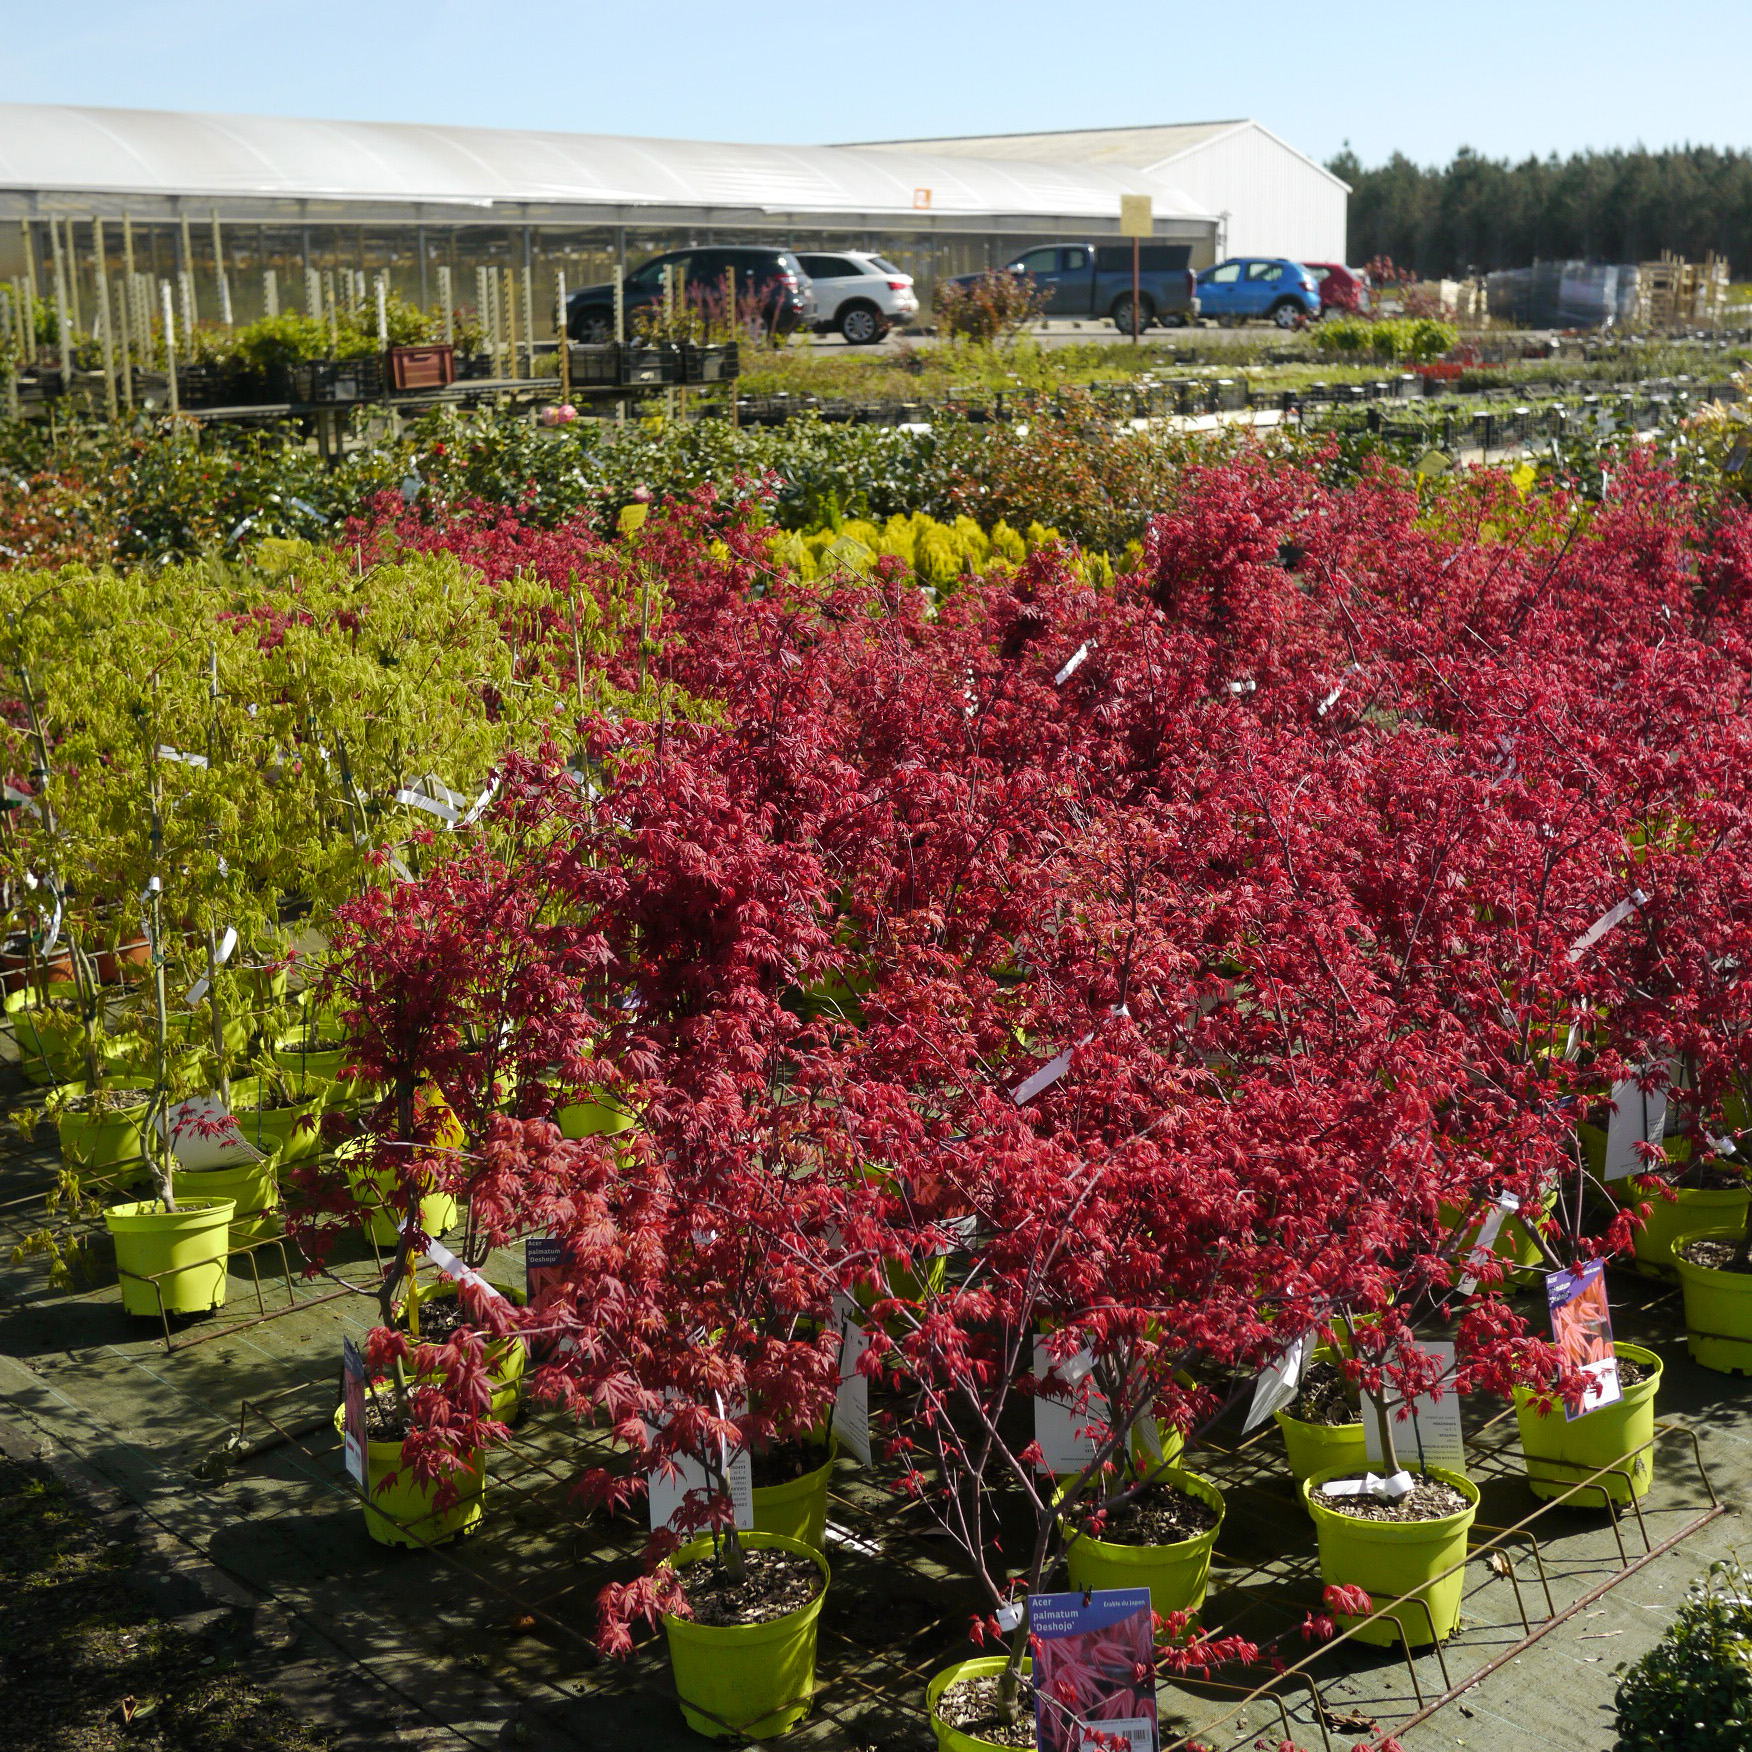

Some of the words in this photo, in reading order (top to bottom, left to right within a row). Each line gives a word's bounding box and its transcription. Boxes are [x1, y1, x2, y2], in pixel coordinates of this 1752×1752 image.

[1032, 1598, 1052, 1607] Acer
[1033, 1609, 1079, 1622] palmatum
[1033, 1621, 1075, 1632] 'Deshojo'
